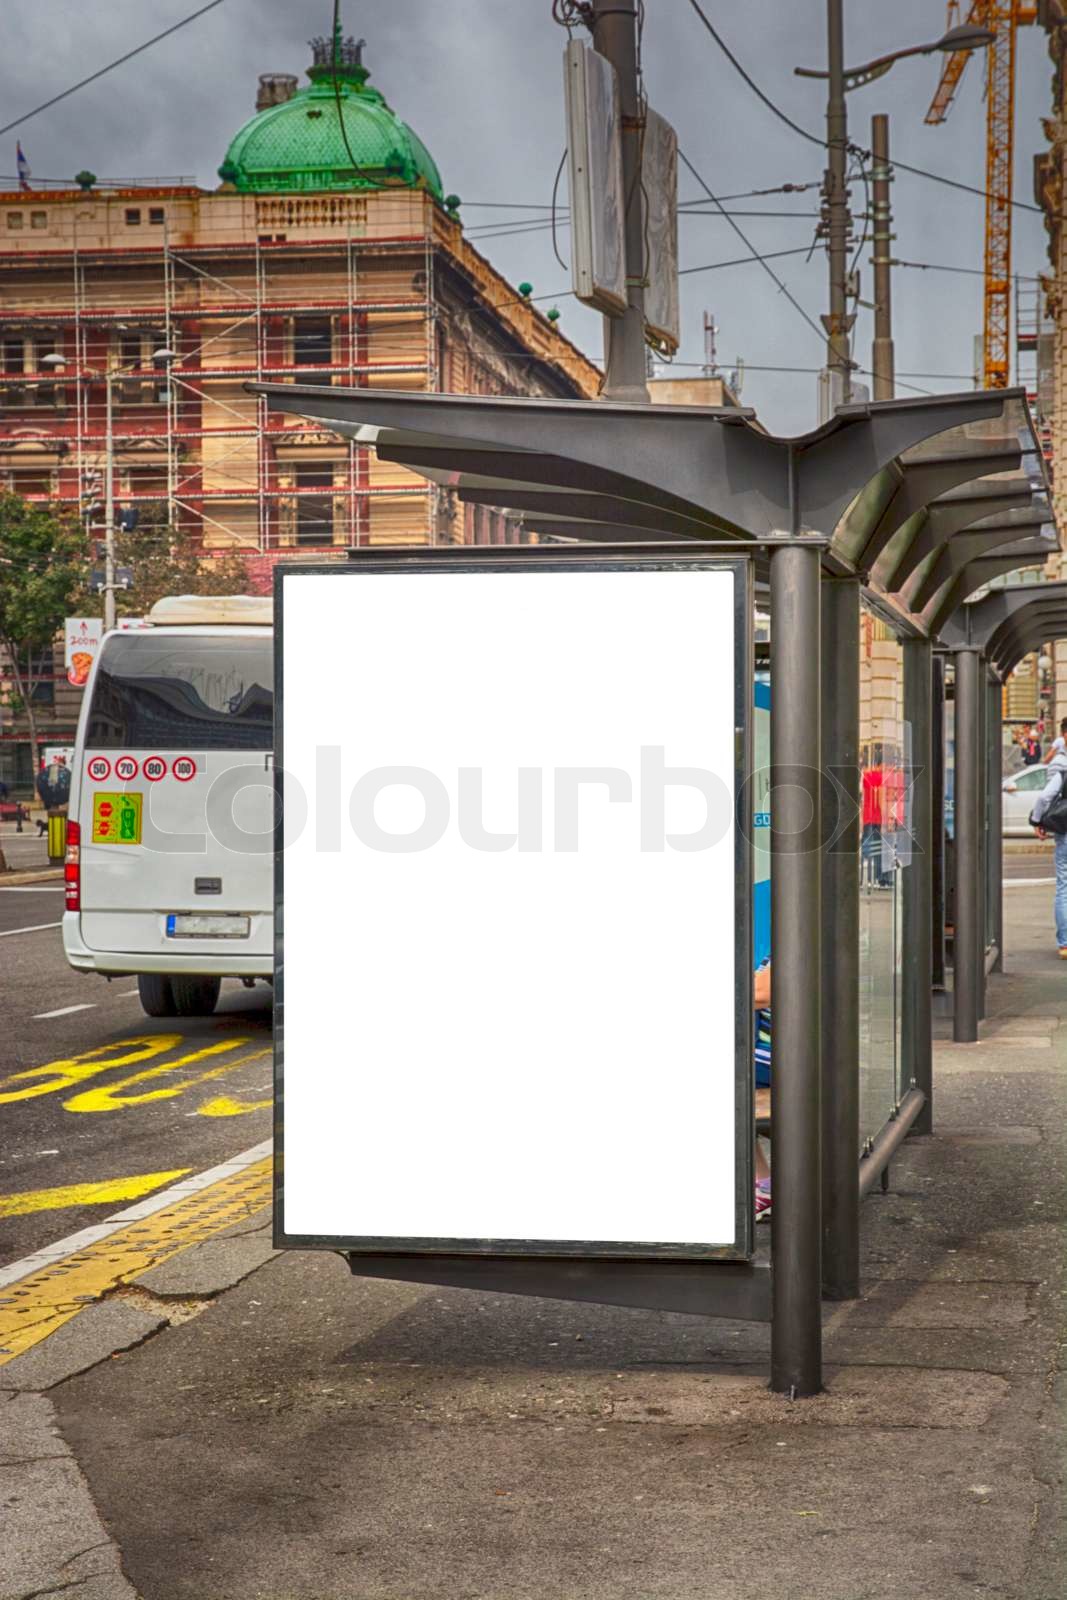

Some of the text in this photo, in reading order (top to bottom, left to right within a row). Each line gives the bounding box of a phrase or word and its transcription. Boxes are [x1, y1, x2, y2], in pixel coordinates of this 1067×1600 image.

[93, 763, 191, 775] 50 70 80 100
